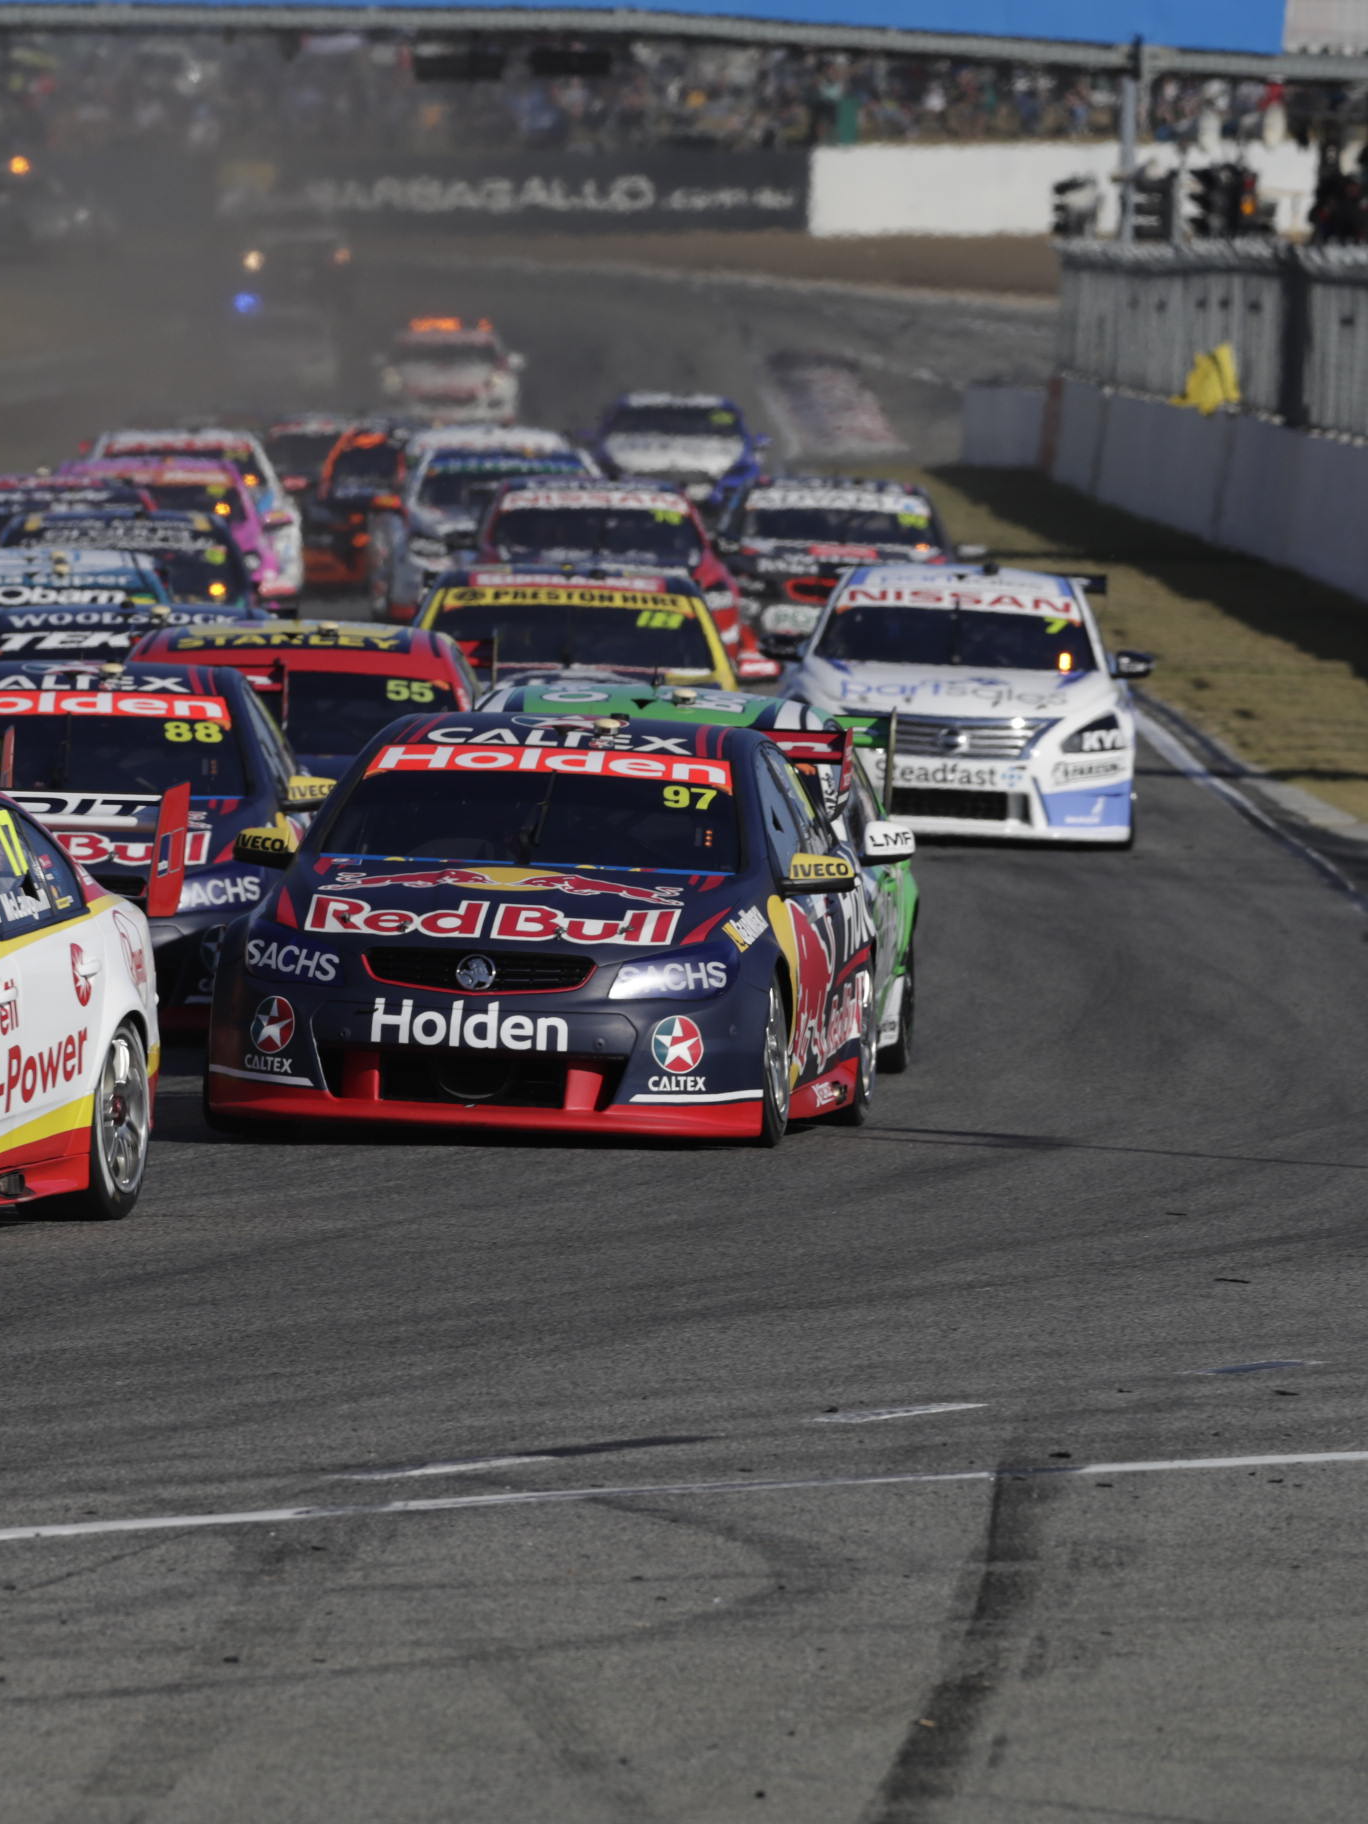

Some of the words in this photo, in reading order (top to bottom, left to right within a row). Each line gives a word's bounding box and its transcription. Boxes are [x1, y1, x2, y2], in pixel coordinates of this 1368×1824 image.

[848, 589, 1072, 614] NISSAN
[9, 611, 238, 628] WOODSOCK
[1044, 616, 1069, 635] 7
[177, 633, 401, 650] STANLEY
[385, 678, 436, 704] 55
[163, 720, 224, 744] 88
[426, 726, 694, 757] CALTEX
[375, 746, 727, 787] Holden
[662, 786, 718, 811] 97
[53, 831, 212, 866] Bul
[236, 832, 286, 853] IVECO
[869, 830, 912, 848] LMF
[792, 863, 850, 878] IVECO
[304, 893, 489, 939] Red
[490, 903, 683, 946] Bull
[247, 938, 341, 982] SACHS
[617, 960, 728, 993] SACHS
[370, 996, 570, 1053] Holden
[244, 1053, 293, 1074] CALTEX
[647, 1074, 706, 1092] CALTEX
